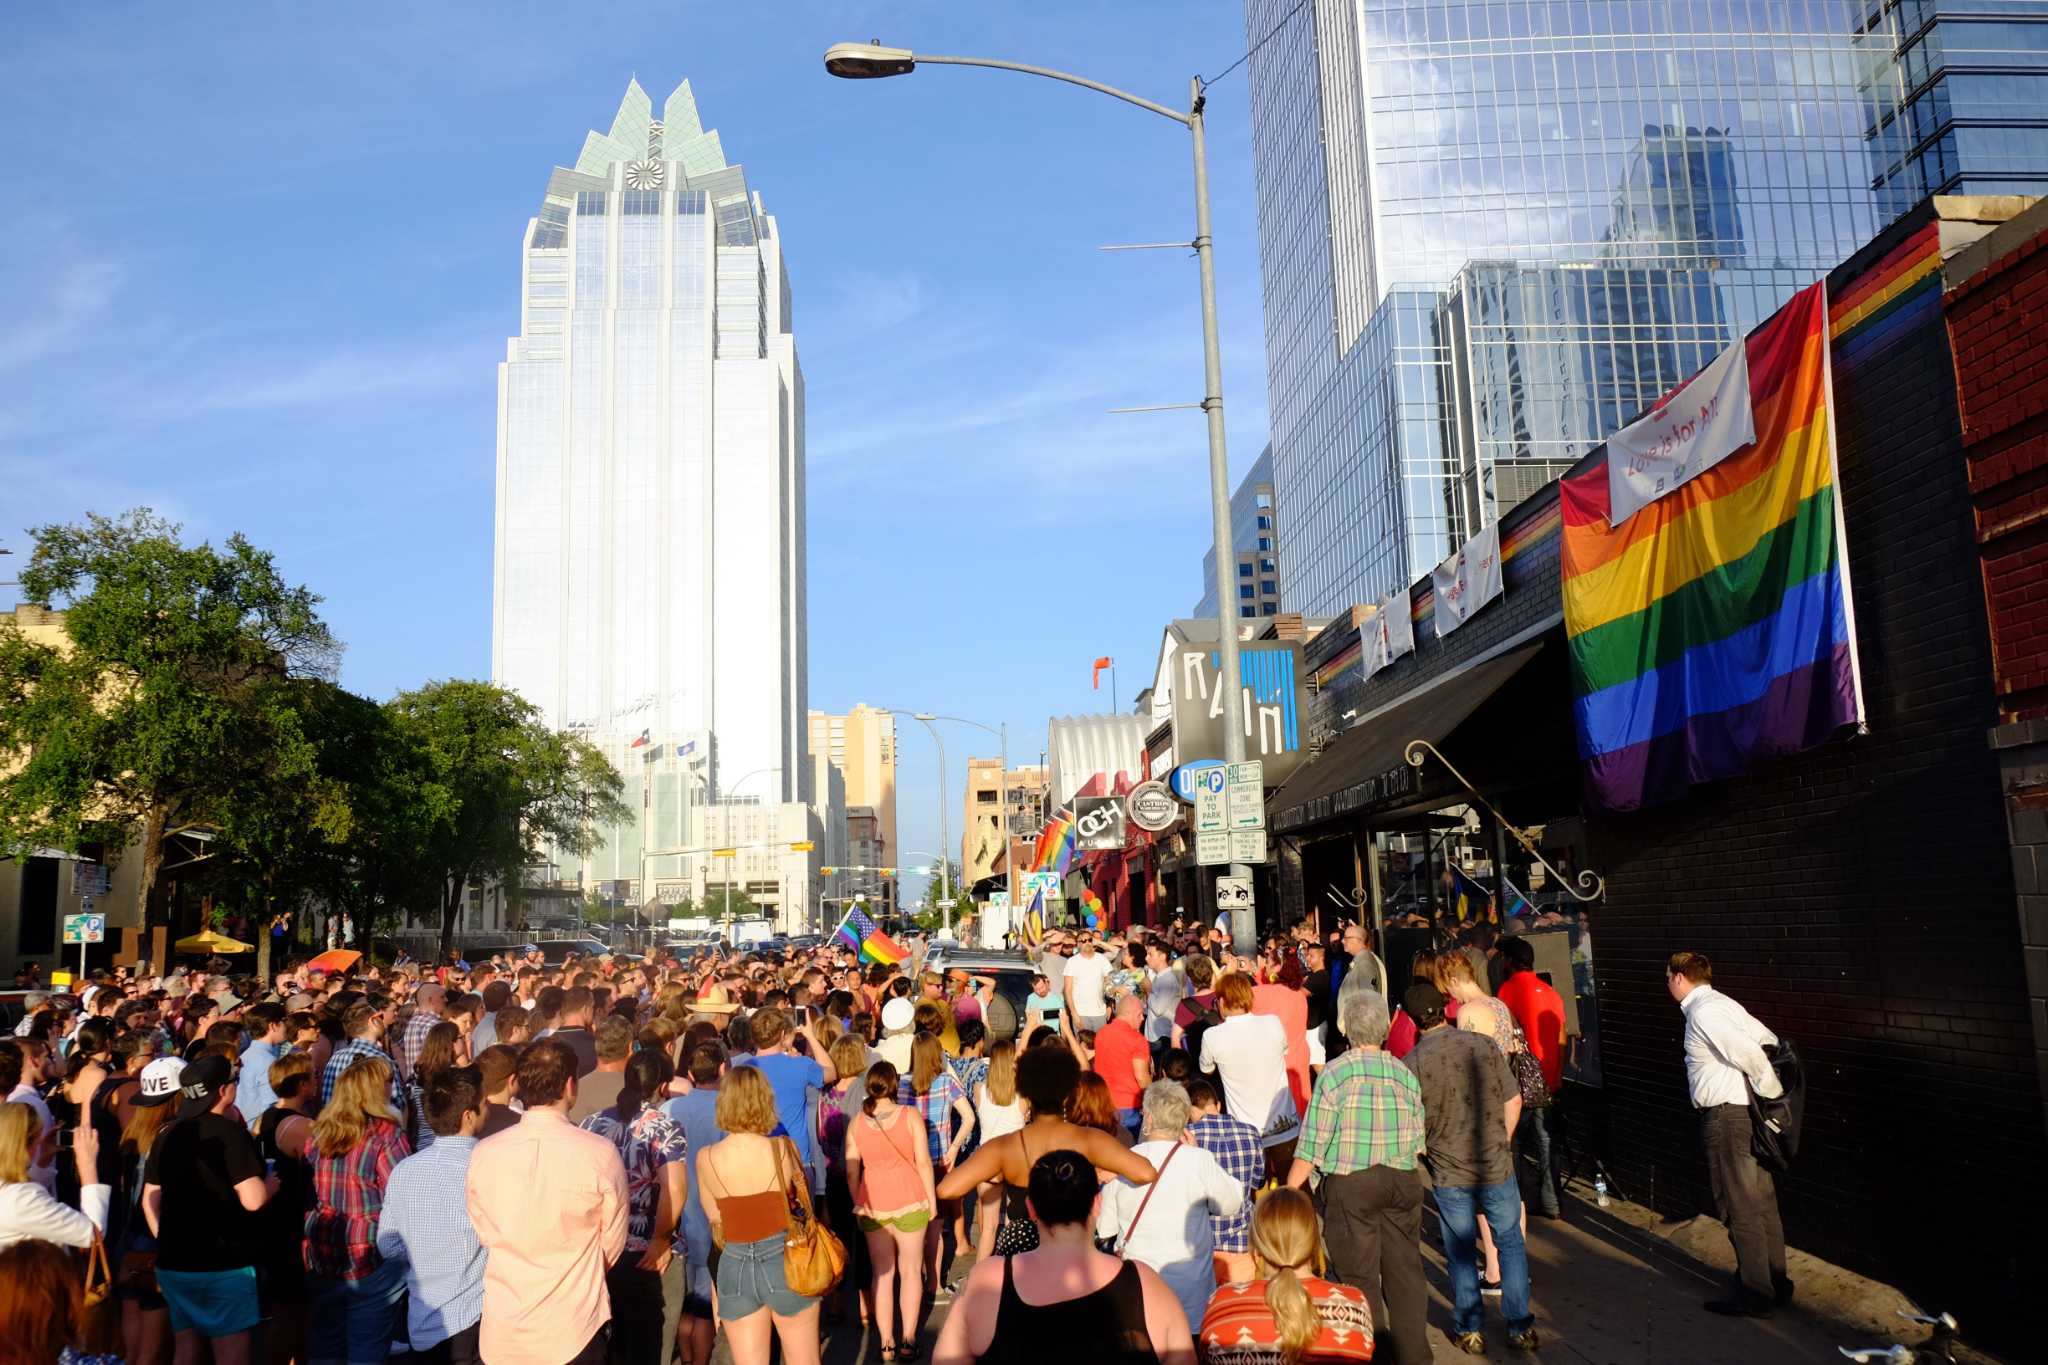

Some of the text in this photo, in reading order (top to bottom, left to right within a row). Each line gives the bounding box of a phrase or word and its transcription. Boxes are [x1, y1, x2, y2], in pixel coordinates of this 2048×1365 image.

[1659, 435, 1673, 457] is
[1672, 419, 1695, 448] for
[1077, 799, 1124, 837] OCH
[1207, 803, 1217, 811] TO
